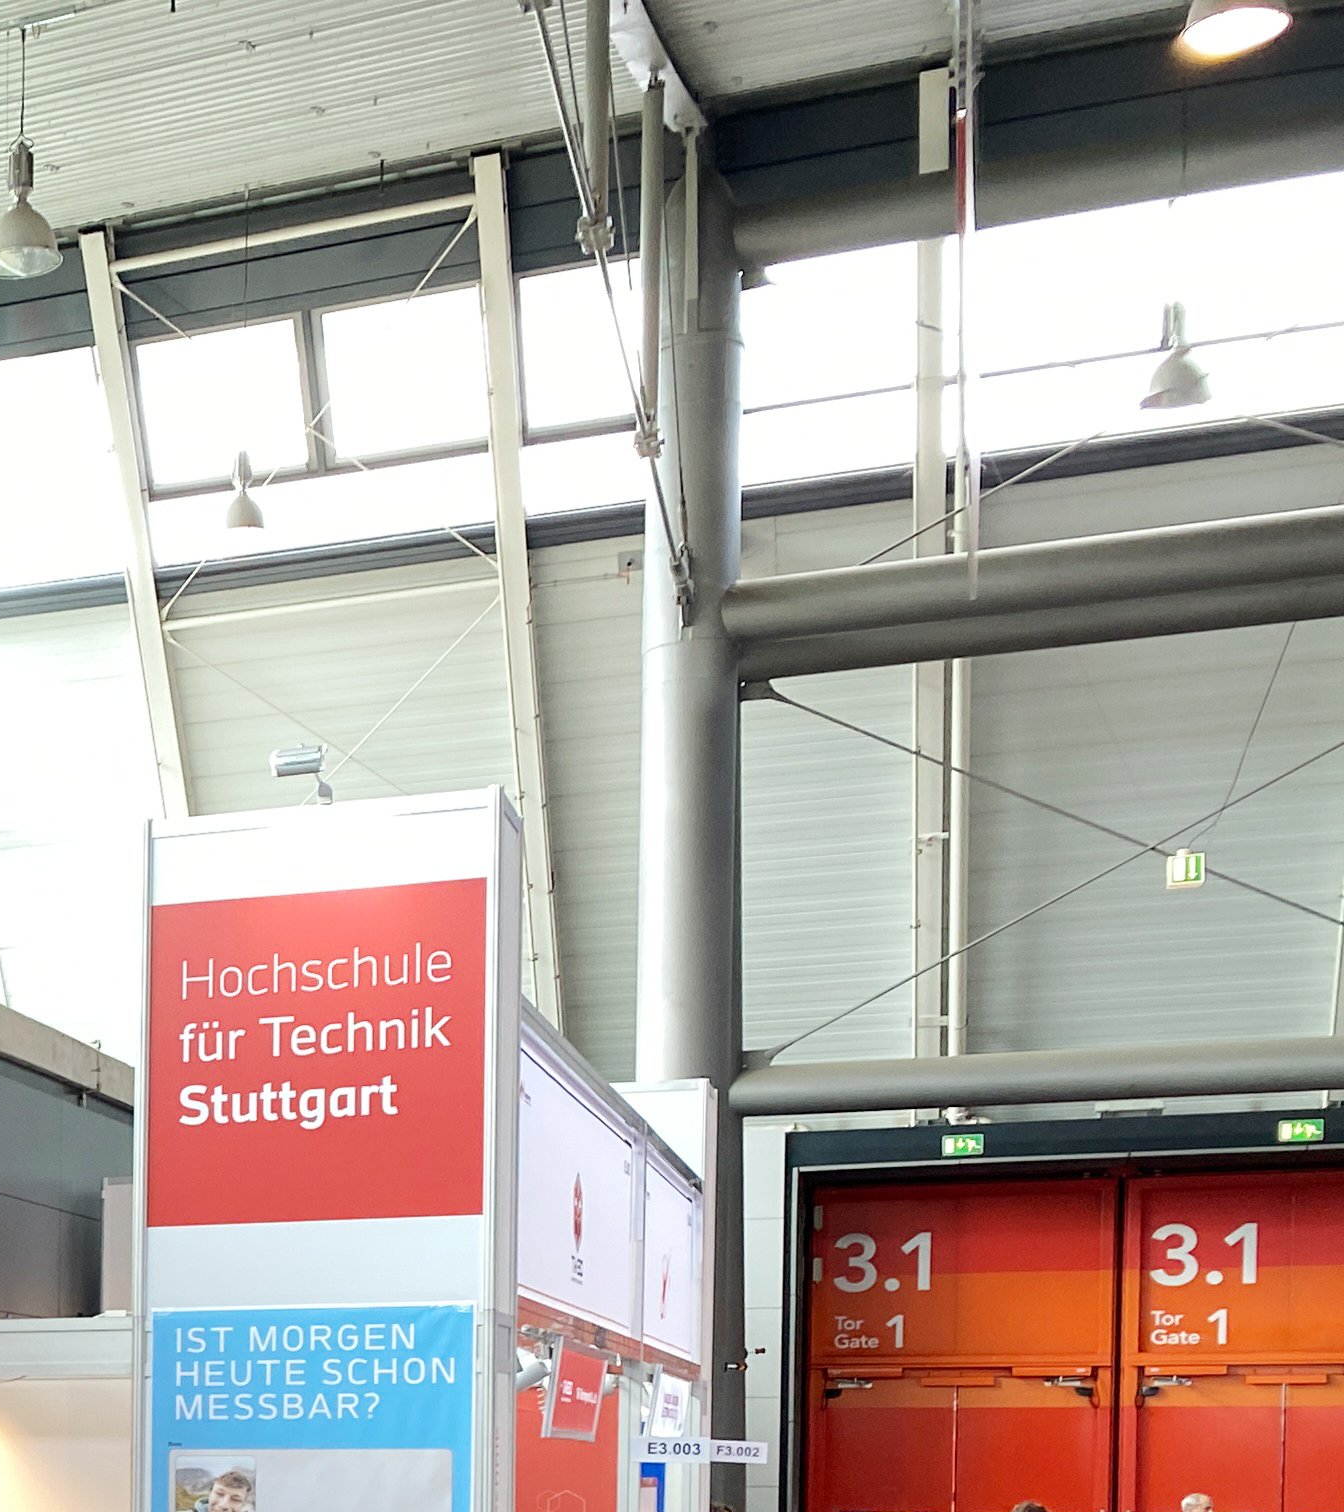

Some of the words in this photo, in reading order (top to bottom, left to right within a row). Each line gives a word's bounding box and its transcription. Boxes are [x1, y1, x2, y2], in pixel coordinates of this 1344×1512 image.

[182, 942, 452, 999] Hochschule
[179, 1021, 245, 1063] für
[259, 1006, 452, 1057] Technik
[179, 1075, 399, 1130] Stuttgart
[833, 1231, 932, 1293] 3.1
[1150, 1222, 1258, 1287] 3.1
[175, 1326, 234, 1353] IST
[248, 1323, 415, 1352] MORGEN
[834, 1316, 863, 1331] Tor
[885, 1314, 905, 1349] 1
[834, 1333, 879, 1350] Gate
[1150, 1310, 1183, 1327] Tor
[1207, 1308, 1228, 1346] 1
[1150, 1328, 1200, 1347] Gate
[175, 1360, 307, 1387] HEUTE
[322, 1357, 455, 1386] SCHON
[175, 1392, 381, 1421] MESSBAR?
[647, 1442, 701, 1456] E3.003
[716, 1445, 760, 1458] F3.002
